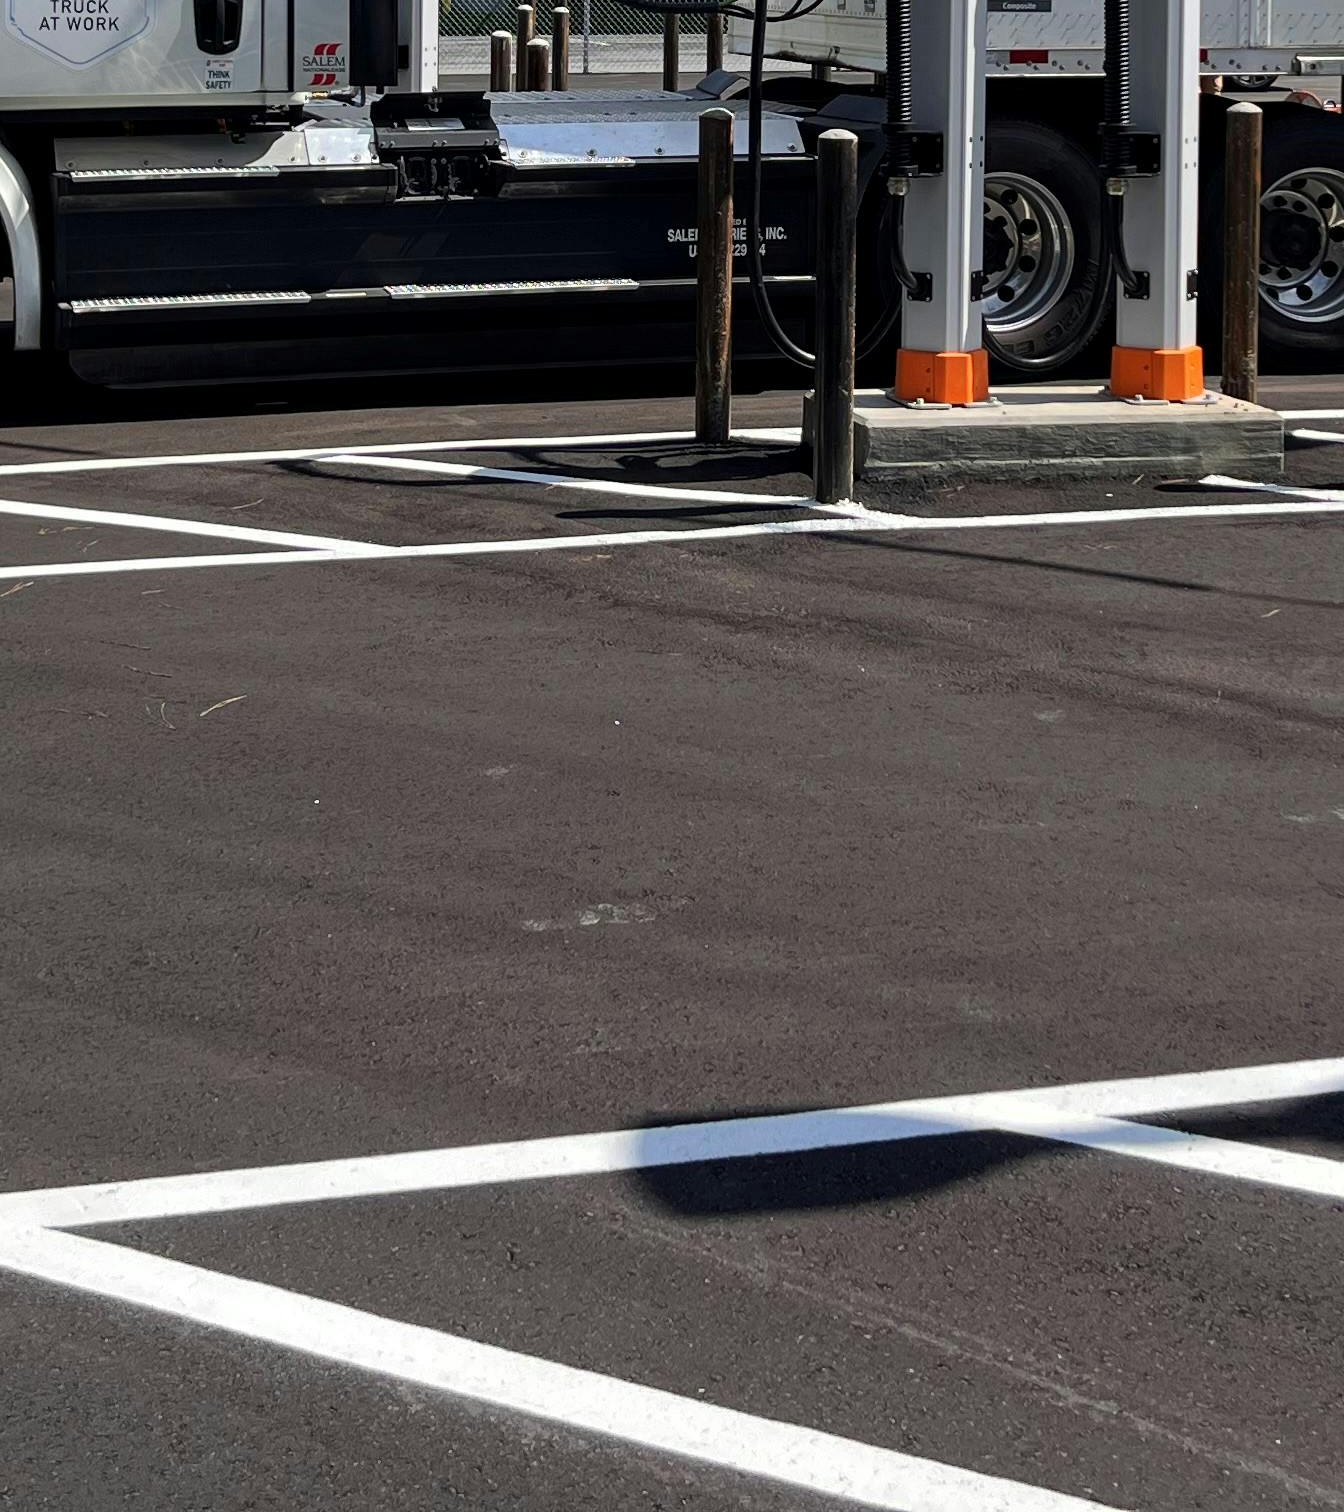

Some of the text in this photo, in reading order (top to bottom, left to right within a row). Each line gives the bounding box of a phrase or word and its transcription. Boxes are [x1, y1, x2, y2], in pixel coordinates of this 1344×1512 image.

[50, 0, 110, 14] TRUCK
[38, 16, 120, 32] AT WORK
[302, 55, 346, 67] SALEM
[207, 70, 231, 79] THINK
[206, 80, 233, 90] SAFETY
[667, 228, 699, 243] SALE
[765, 227, 788, 240] INC.
